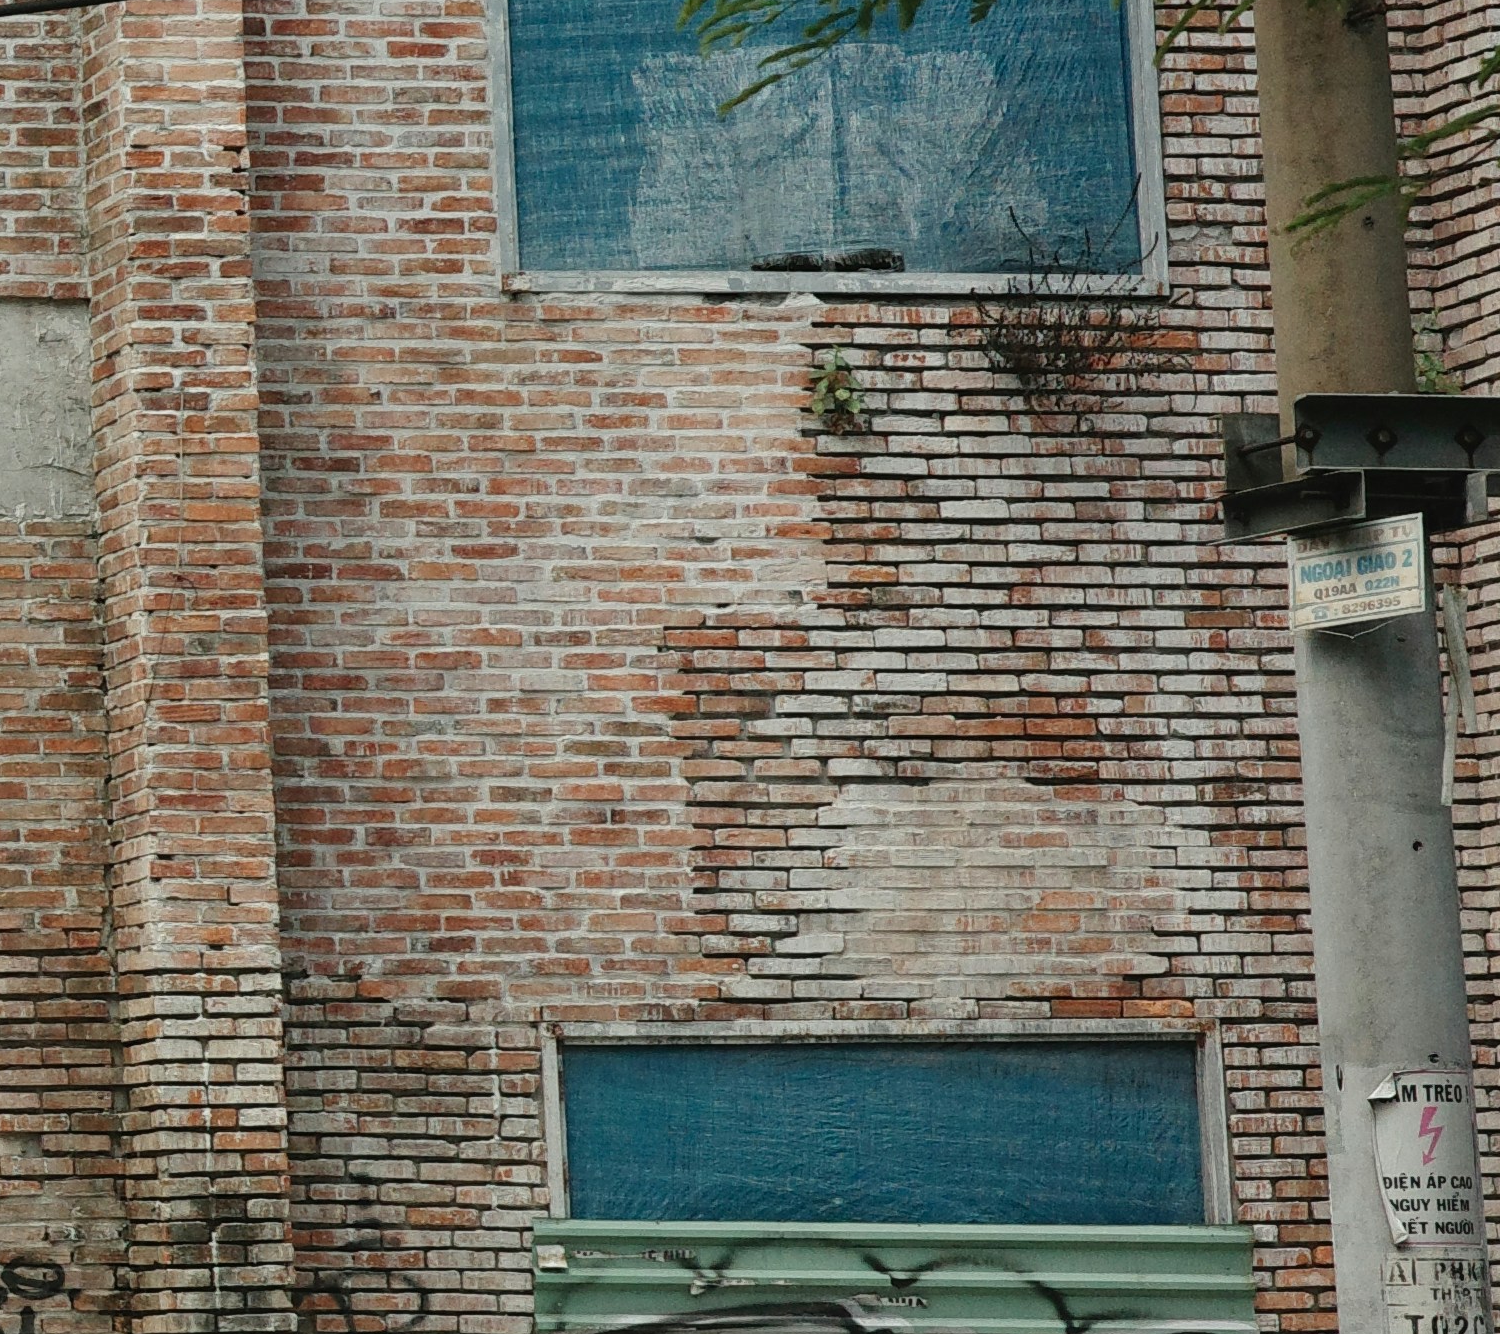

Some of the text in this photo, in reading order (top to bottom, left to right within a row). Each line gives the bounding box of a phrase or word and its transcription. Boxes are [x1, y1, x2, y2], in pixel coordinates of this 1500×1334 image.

[1300, 548, 1413, 584] NGOẠI GIAO 2
[1426, 1172, 1447, 1189] ÁP
[1450, 1175, 1473, 1190] CAO
[1436, 1192, 1470, 1212] HIỂM
